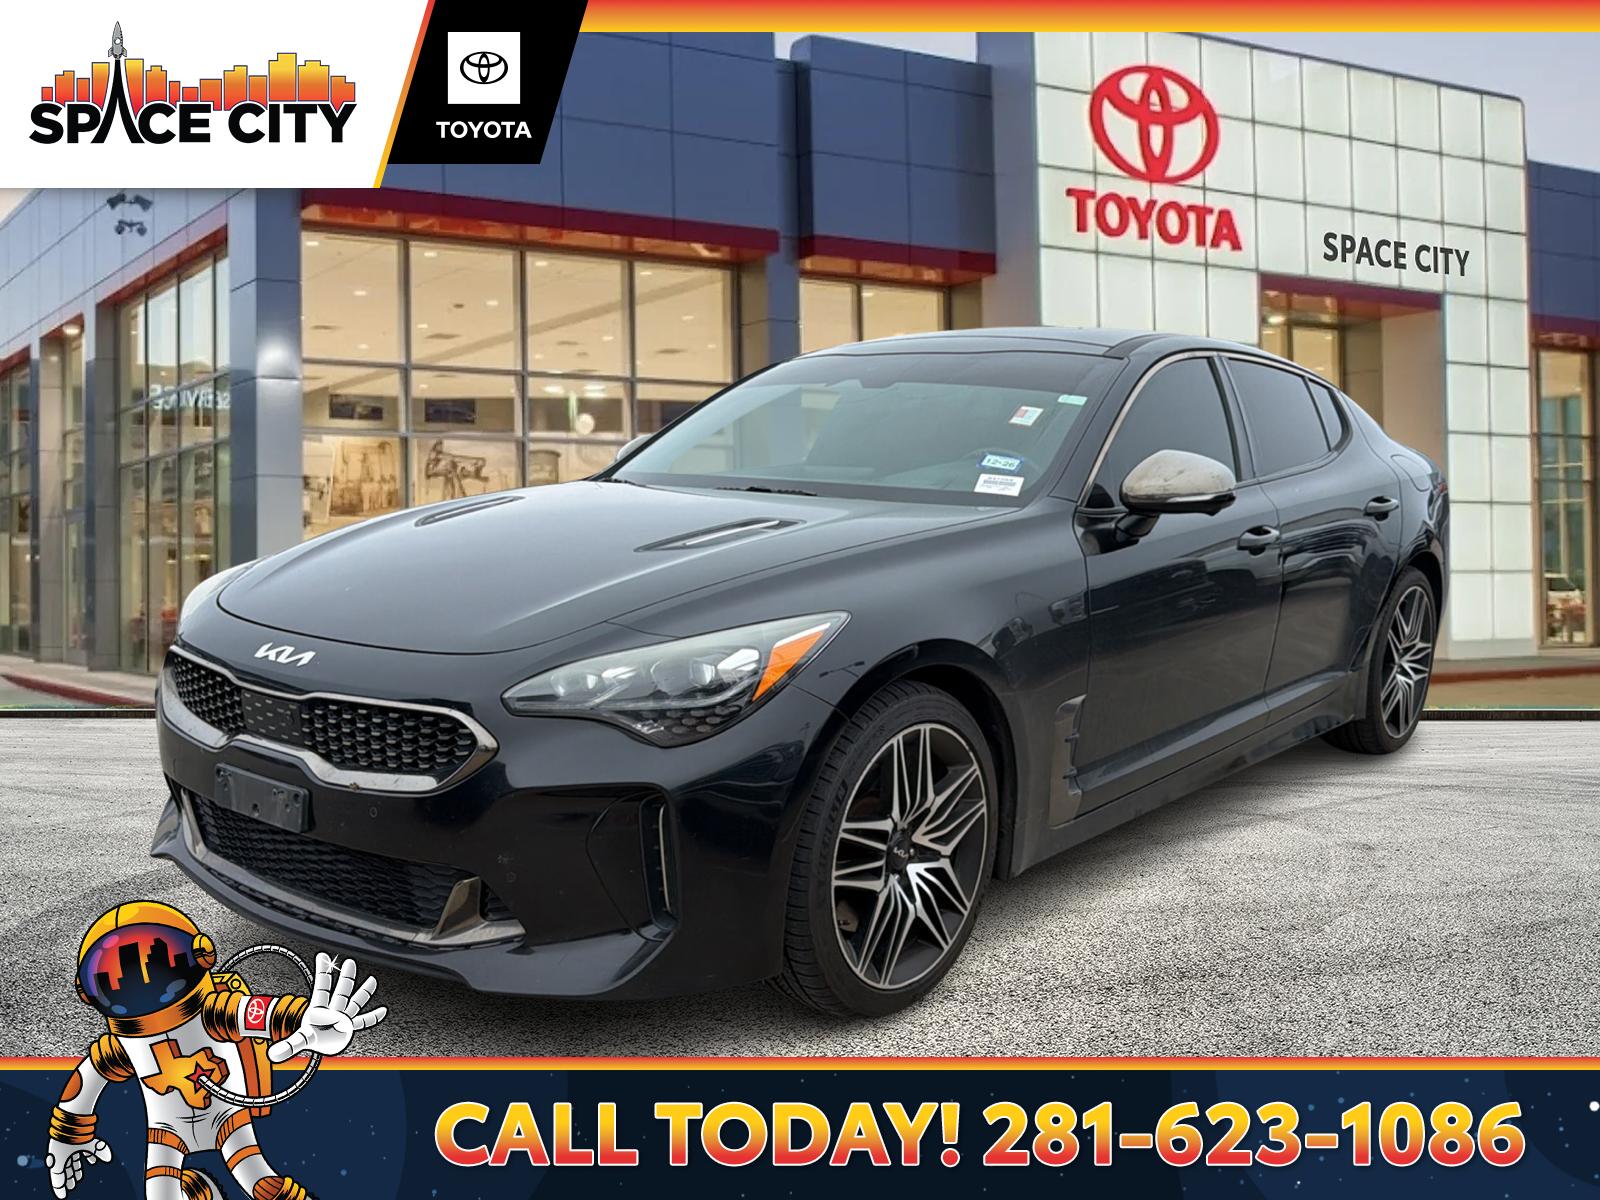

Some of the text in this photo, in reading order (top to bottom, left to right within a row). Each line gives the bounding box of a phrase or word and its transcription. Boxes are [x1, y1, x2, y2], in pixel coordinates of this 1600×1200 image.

[1066, 188, 1242, 252] TOYOTA
[1323, 232, 1470, 277] SPACE CITY
[254, 642, 317, 667] KIA
